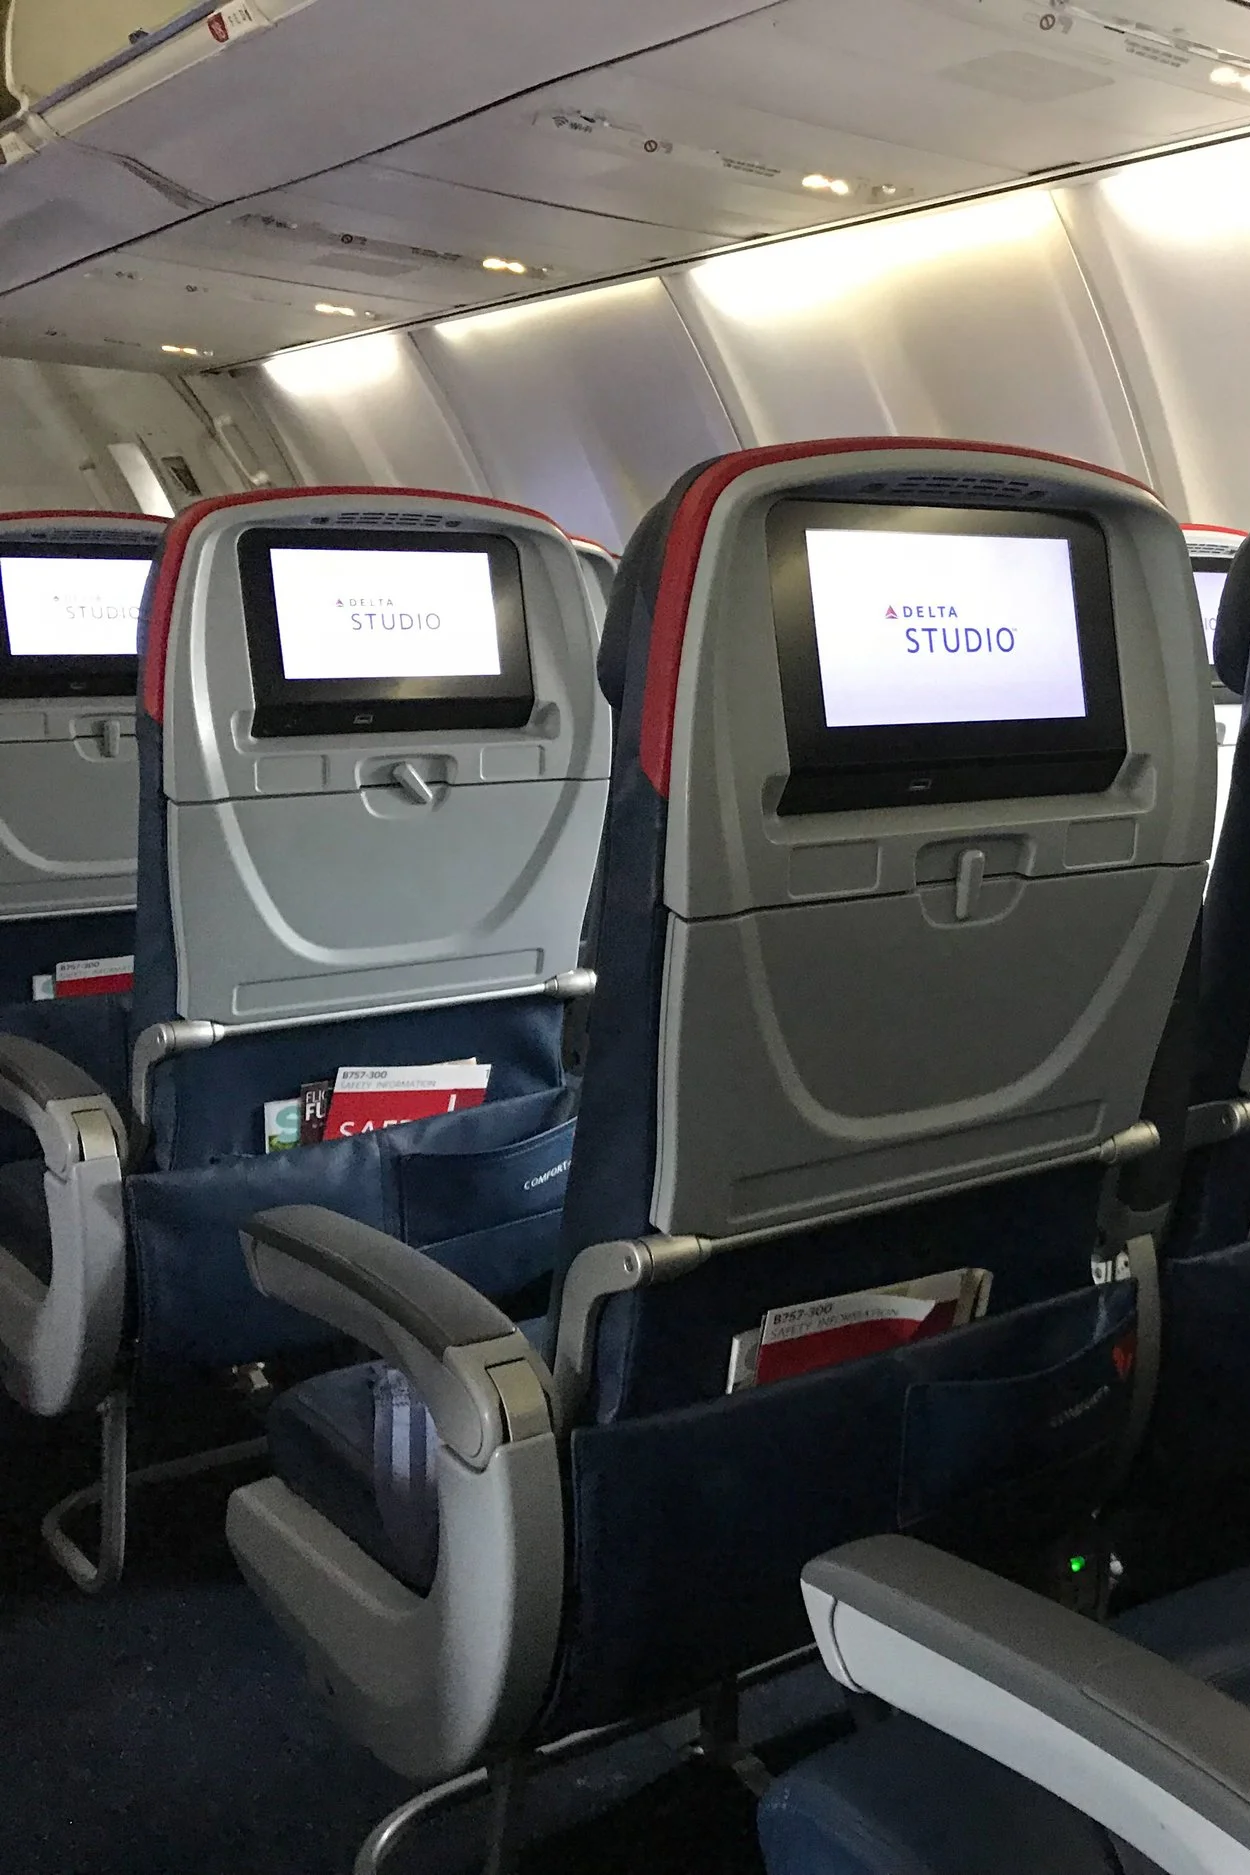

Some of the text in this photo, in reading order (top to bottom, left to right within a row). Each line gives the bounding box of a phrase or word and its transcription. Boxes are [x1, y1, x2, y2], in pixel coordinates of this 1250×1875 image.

[349, 598, 394, 607] DELTA
[902, 605, 958, 618] DELTA
[351, 612, 441, 631] STUDIO
[905, 626, 1015, 654] STUDIO
[342, 1070, 388, 1080] B757-300
[340, 1079, 437, 1090] SAFETY INFORMATION
[773, 1302, 834, 1325] B757-300
